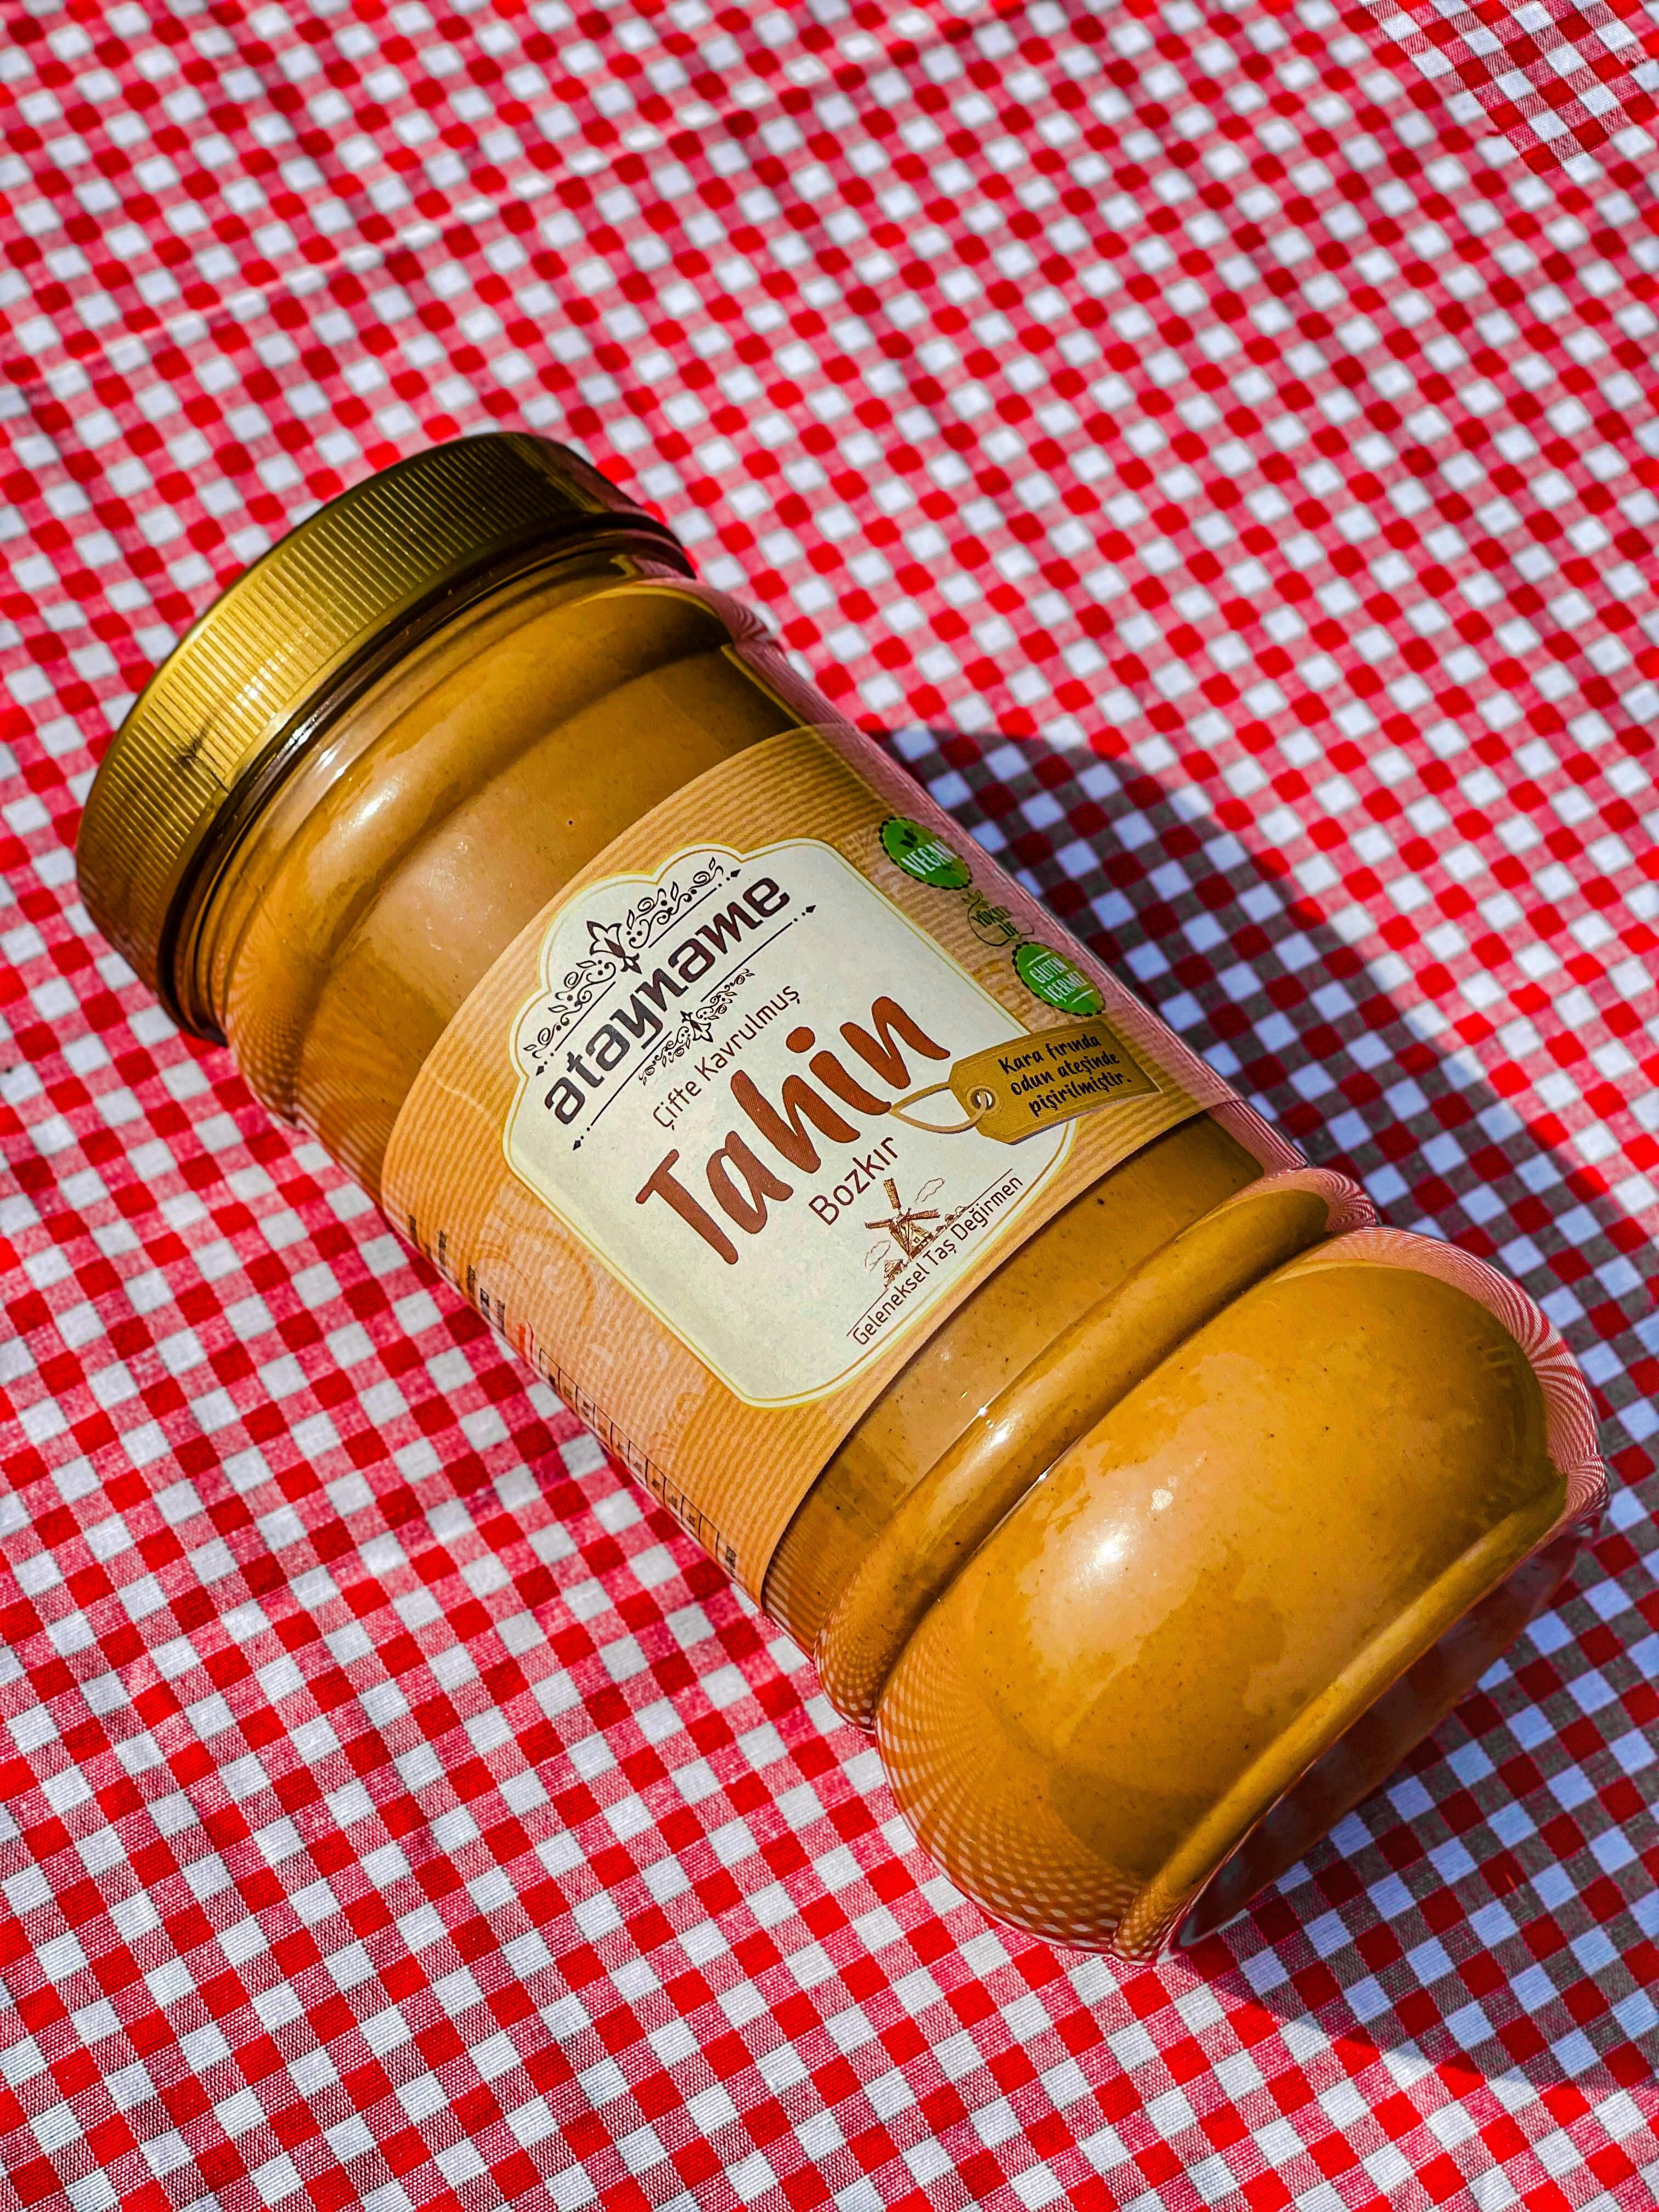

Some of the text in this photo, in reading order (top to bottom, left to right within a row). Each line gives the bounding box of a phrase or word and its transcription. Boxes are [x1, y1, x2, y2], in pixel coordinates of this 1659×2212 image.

[900, 839, 957, 875] VEGAN
[545, 878, 790, 1125] atayname
[653, 986, 800, 1130] Çifte Kavrulmuş
[997, 1034, 1102, 1074] Kara fırında
[1011, 1051, 1120, 1096] odun ateşinde
[1029, 1071, 1132, 1117] pişirilmiştir.
[636, 996, 951, 1265] Tahin
[808, 1137, 899, 1226] Bozkır
[853, 1177, 1023, 1345] Geleneksel Taş Değirmen
